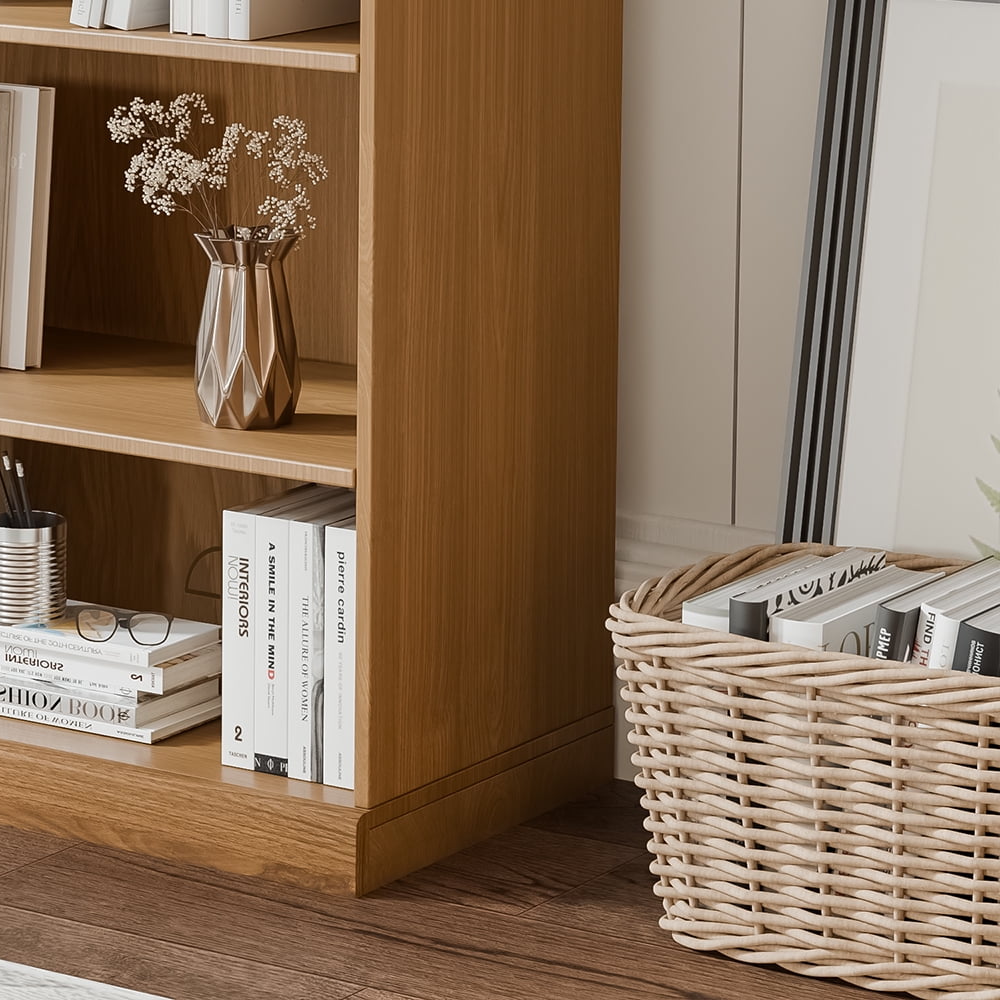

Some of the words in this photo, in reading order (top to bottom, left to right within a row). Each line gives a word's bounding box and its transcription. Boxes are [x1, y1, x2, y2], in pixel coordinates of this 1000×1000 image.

[268, 542, 276, 551] A
[268, 555, 276, 596] SMILE
[337, 551, 346, 595] pierre
[238, 557, 250, 638] INTERIORS
[268, 599, 276, 613] IN
[301, 597, 309, 618] THE
[268, 616, 276, 642] THE
[337, 598, 345, 644] cardin
[923, 612, 937, 645] FIND
[301, 619, 309, 660] ALLURE
[876, 627, 892, 661] РМЕР
[267, 643, 275, 680] MIND
[301, 661, 309, 677] OF
[972, 641, 985, 676] ОНИСТ
[301, 679, 309, 722] WOMEN
[234, 725, 243, 742] 2
